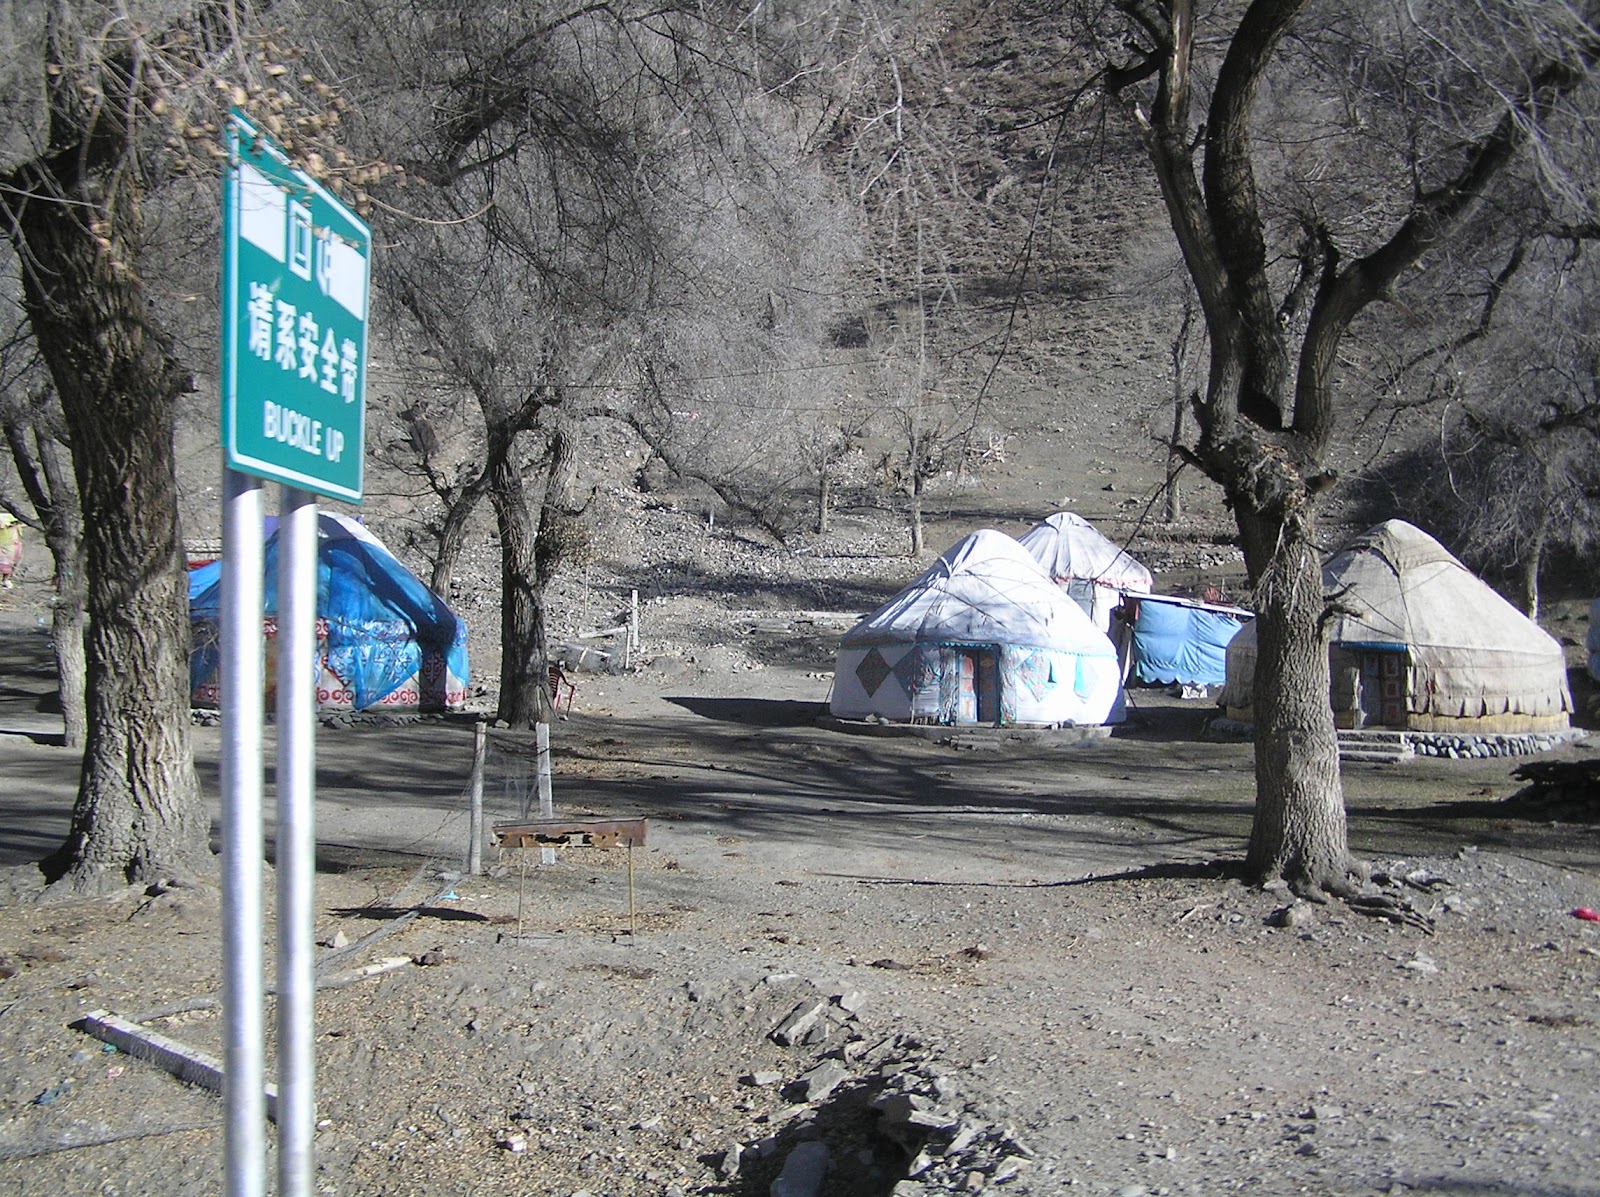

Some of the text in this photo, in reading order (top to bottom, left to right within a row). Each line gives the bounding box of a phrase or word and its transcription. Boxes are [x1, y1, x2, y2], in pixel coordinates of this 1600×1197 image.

[247, 281, 358, 403] 请系安全带
[263, 400, 344, 462] BUCKLE UP
